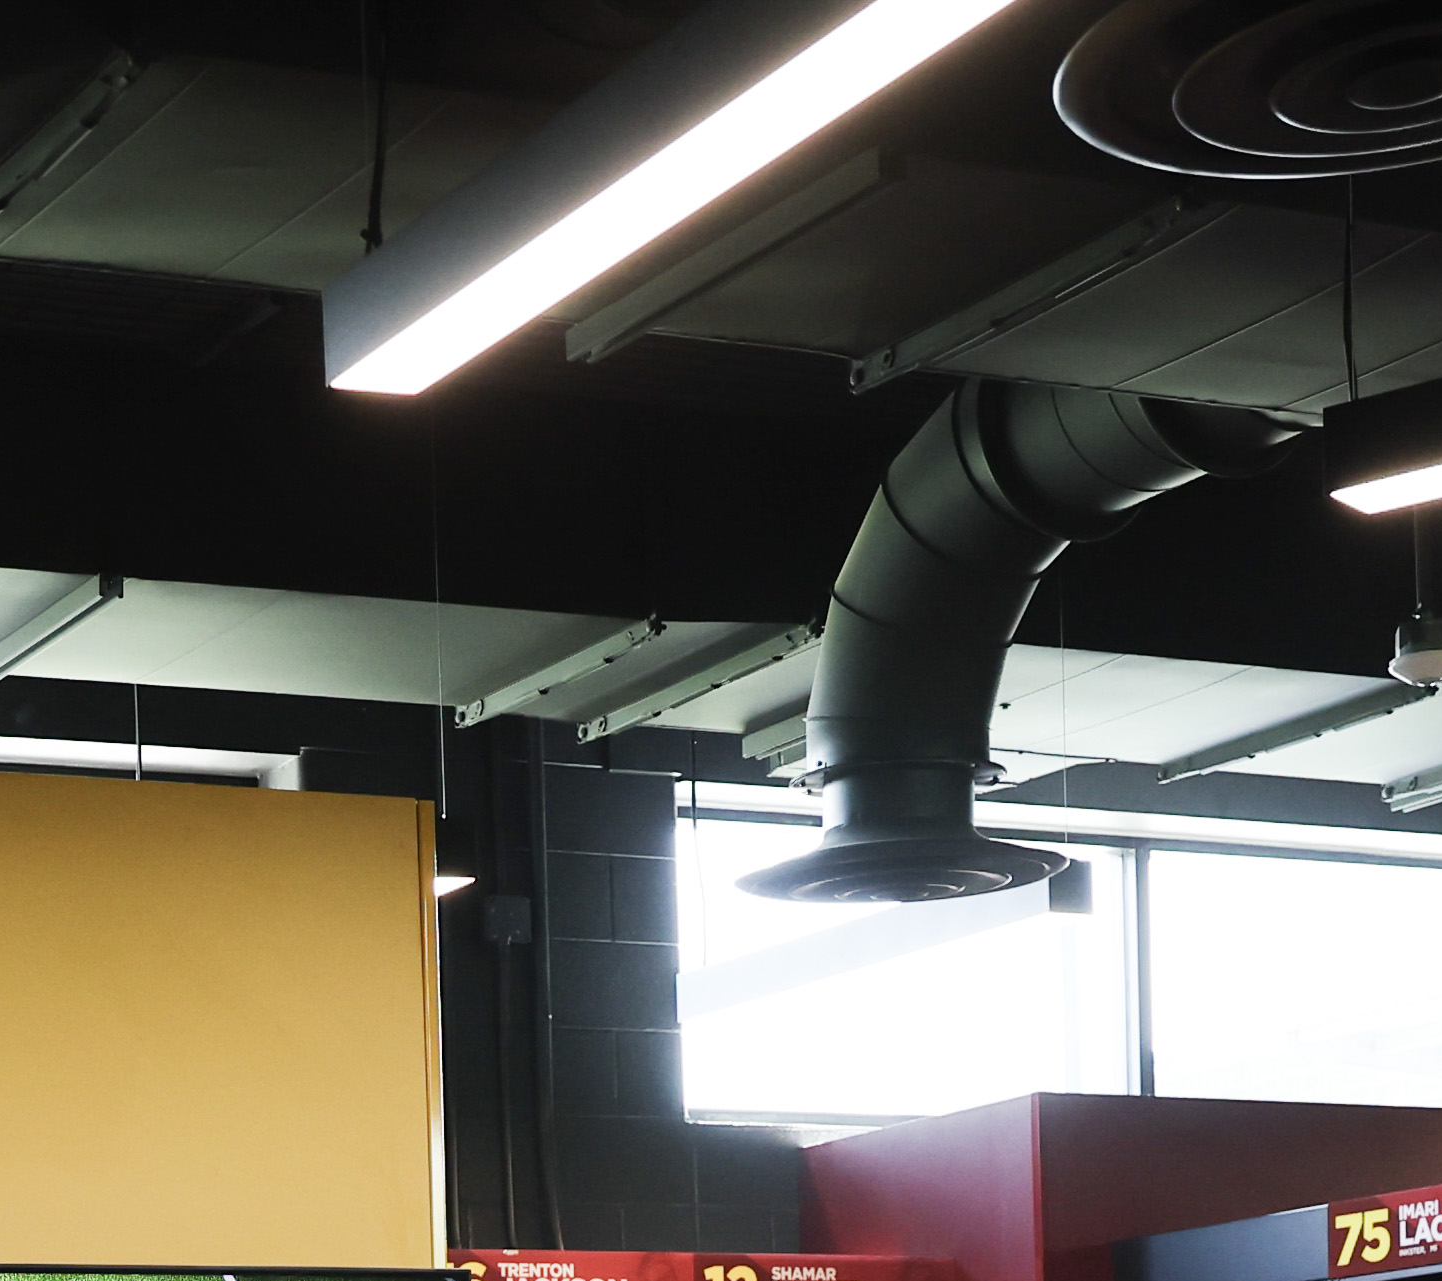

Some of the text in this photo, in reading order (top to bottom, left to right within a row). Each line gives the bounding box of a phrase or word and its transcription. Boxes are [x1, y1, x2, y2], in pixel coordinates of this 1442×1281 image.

[1398, 1199, 1439, 1221] IMARI
[1335, 1208, 1391, 1266] 75
[498, 1263, 575, 1278] TRENTON
[771, 1266, 836, 1281] SHAMAR
